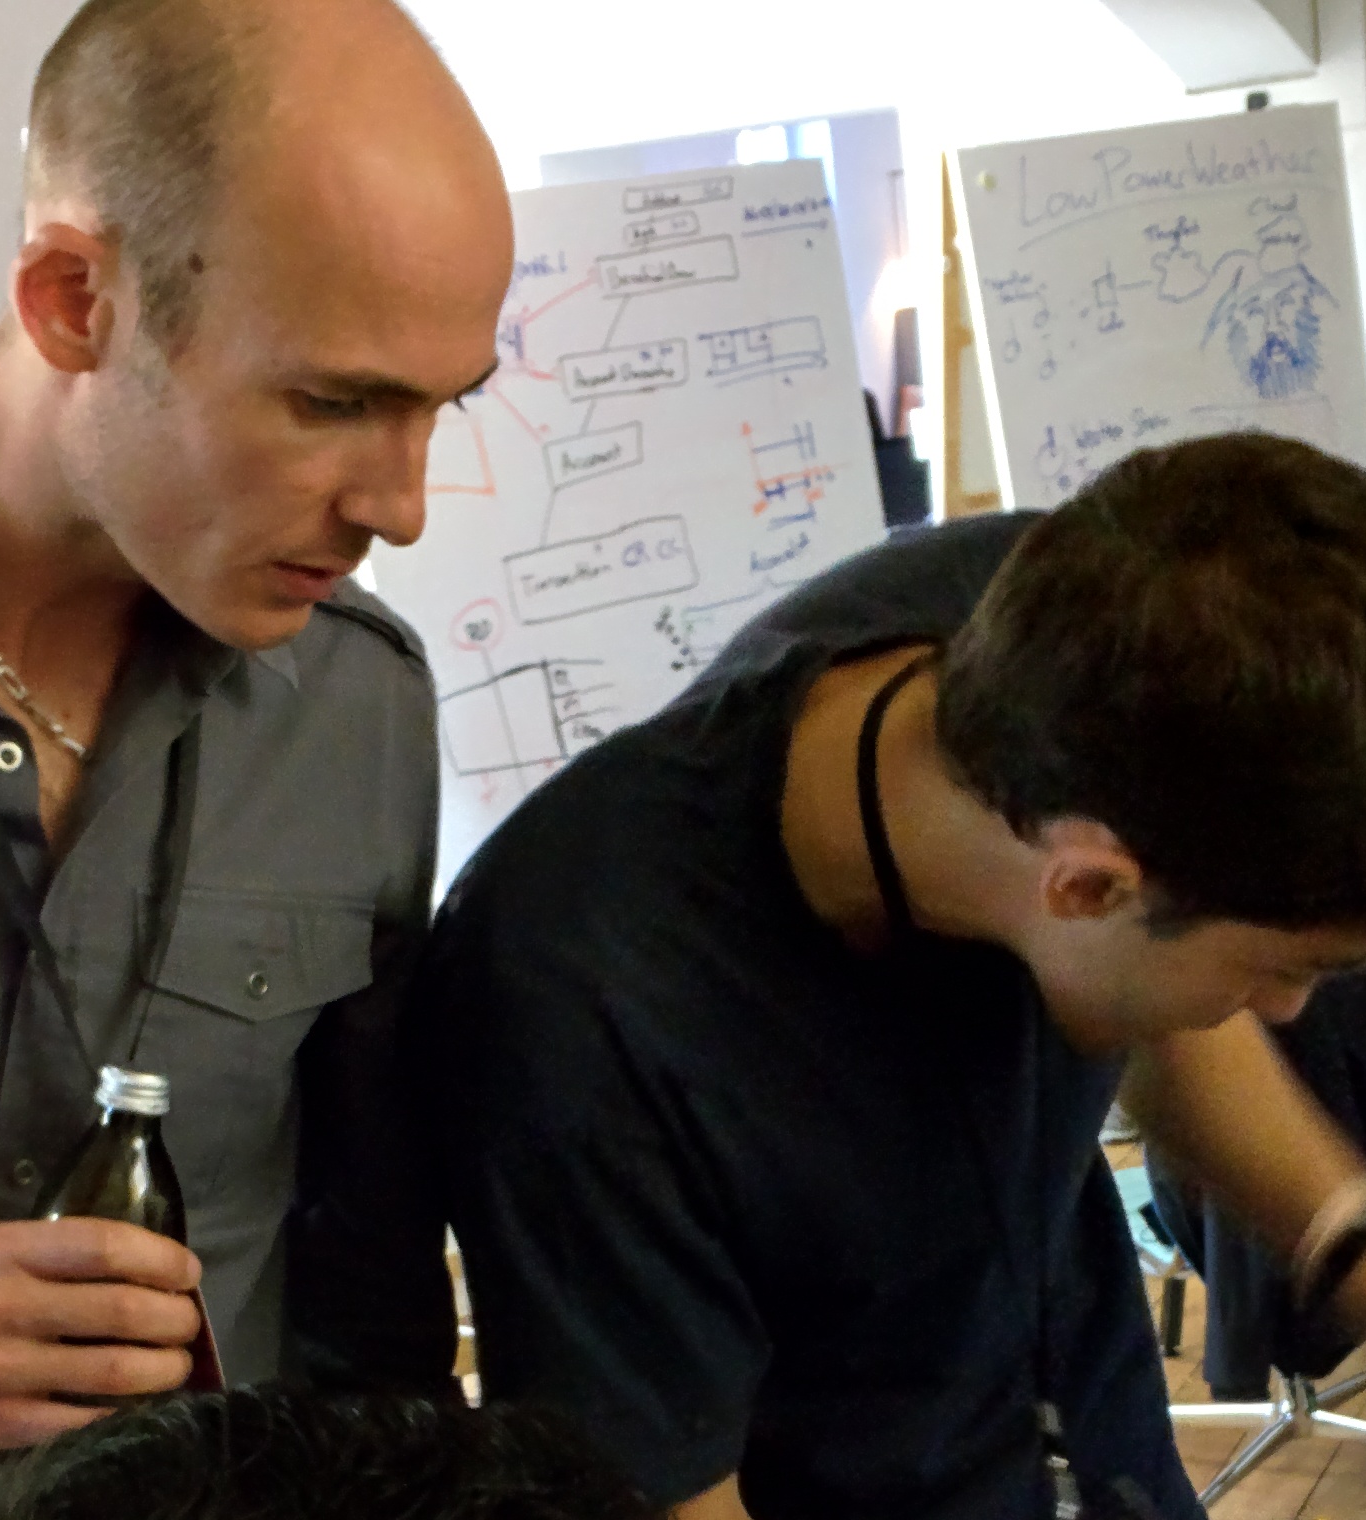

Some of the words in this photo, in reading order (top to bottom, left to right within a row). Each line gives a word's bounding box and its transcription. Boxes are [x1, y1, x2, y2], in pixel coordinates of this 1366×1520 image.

[1019, 153, 1099, 228] Low
[1092, 145, 1186, 194] Power
[1184, 137, 1320, 188] Weather
